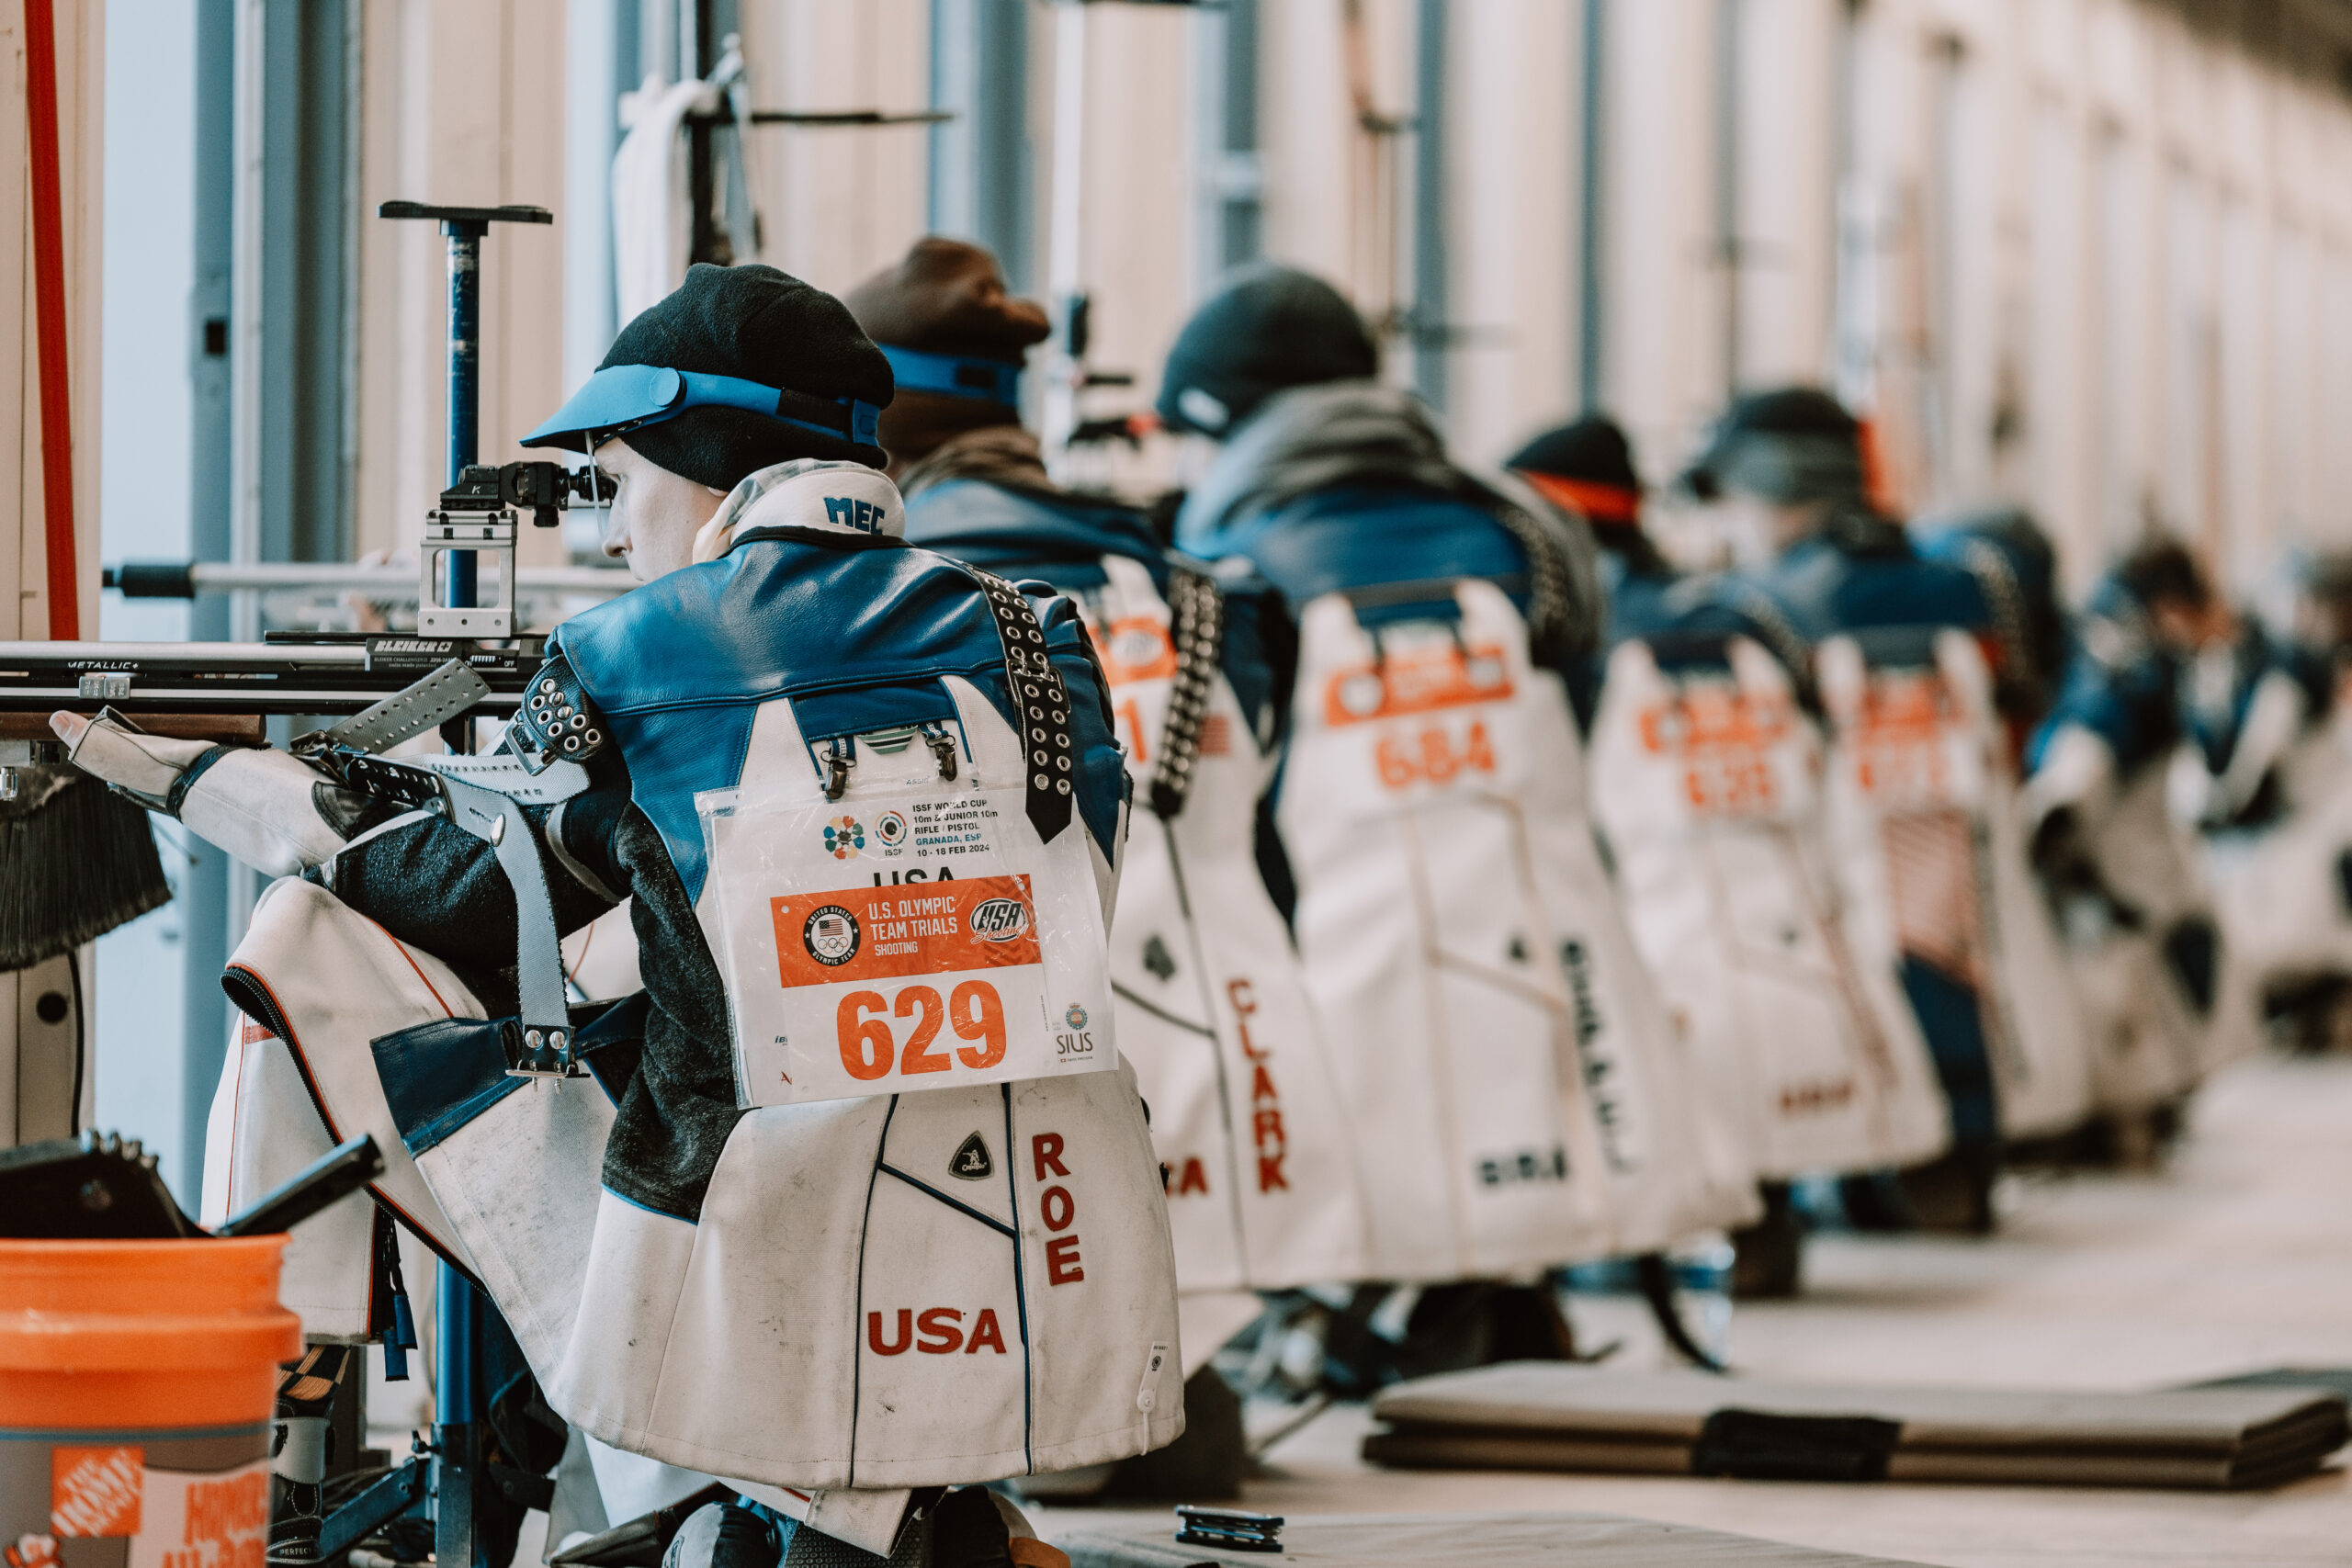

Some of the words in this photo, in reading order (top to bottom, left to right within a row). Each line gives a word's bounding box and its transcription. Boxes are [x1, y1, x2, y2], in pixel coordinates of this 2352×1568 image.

[823, 497, 885, 535] MEC
[374, 640, 436, 652] BLEIKER
[912, 804, 932, 812] ISSF
[969, 799, 987, 807] CUP
[944, 811, 978, 821] JUNIOR
[915, 826, 939, 834] RIFLE
[947, 823, 980, 832] PISTOL
[916, 835, 963, 846] GRANADA,
[965, 833, 982, 841] ESP
[885, 849, 903, 857] ISSF
[949, 846, 966, 854] FEB
[968, 844, 989, 852] 2024
[808, 908, 829, 925] UNITED
[830, 907, 853, 921] STATES
[868, 901, 895, 920] U.S.
[899, 896, 956, 918] OLYMPIC
[977, 902, 1023, 932] USA
[870, 920, 908, 941] TEAM
[910, 917, 958, 937] TRIALS
[812, 951, 839, 964] OLYMPIC
[841, 947, 855, 963] TEAM
[874, 941, 919, 956] SHOOTING
[837, 980, 1006, 1080] 629
[1056, 1032, 1093, 1055] SIUS
[1227, 979, 1289, 1194] CLARK
[1033, 1133, 1085, 1286] ROE
[867, 1307, 1007, 1357] USA
[279, 1547, 312, 1556] PERFEC
